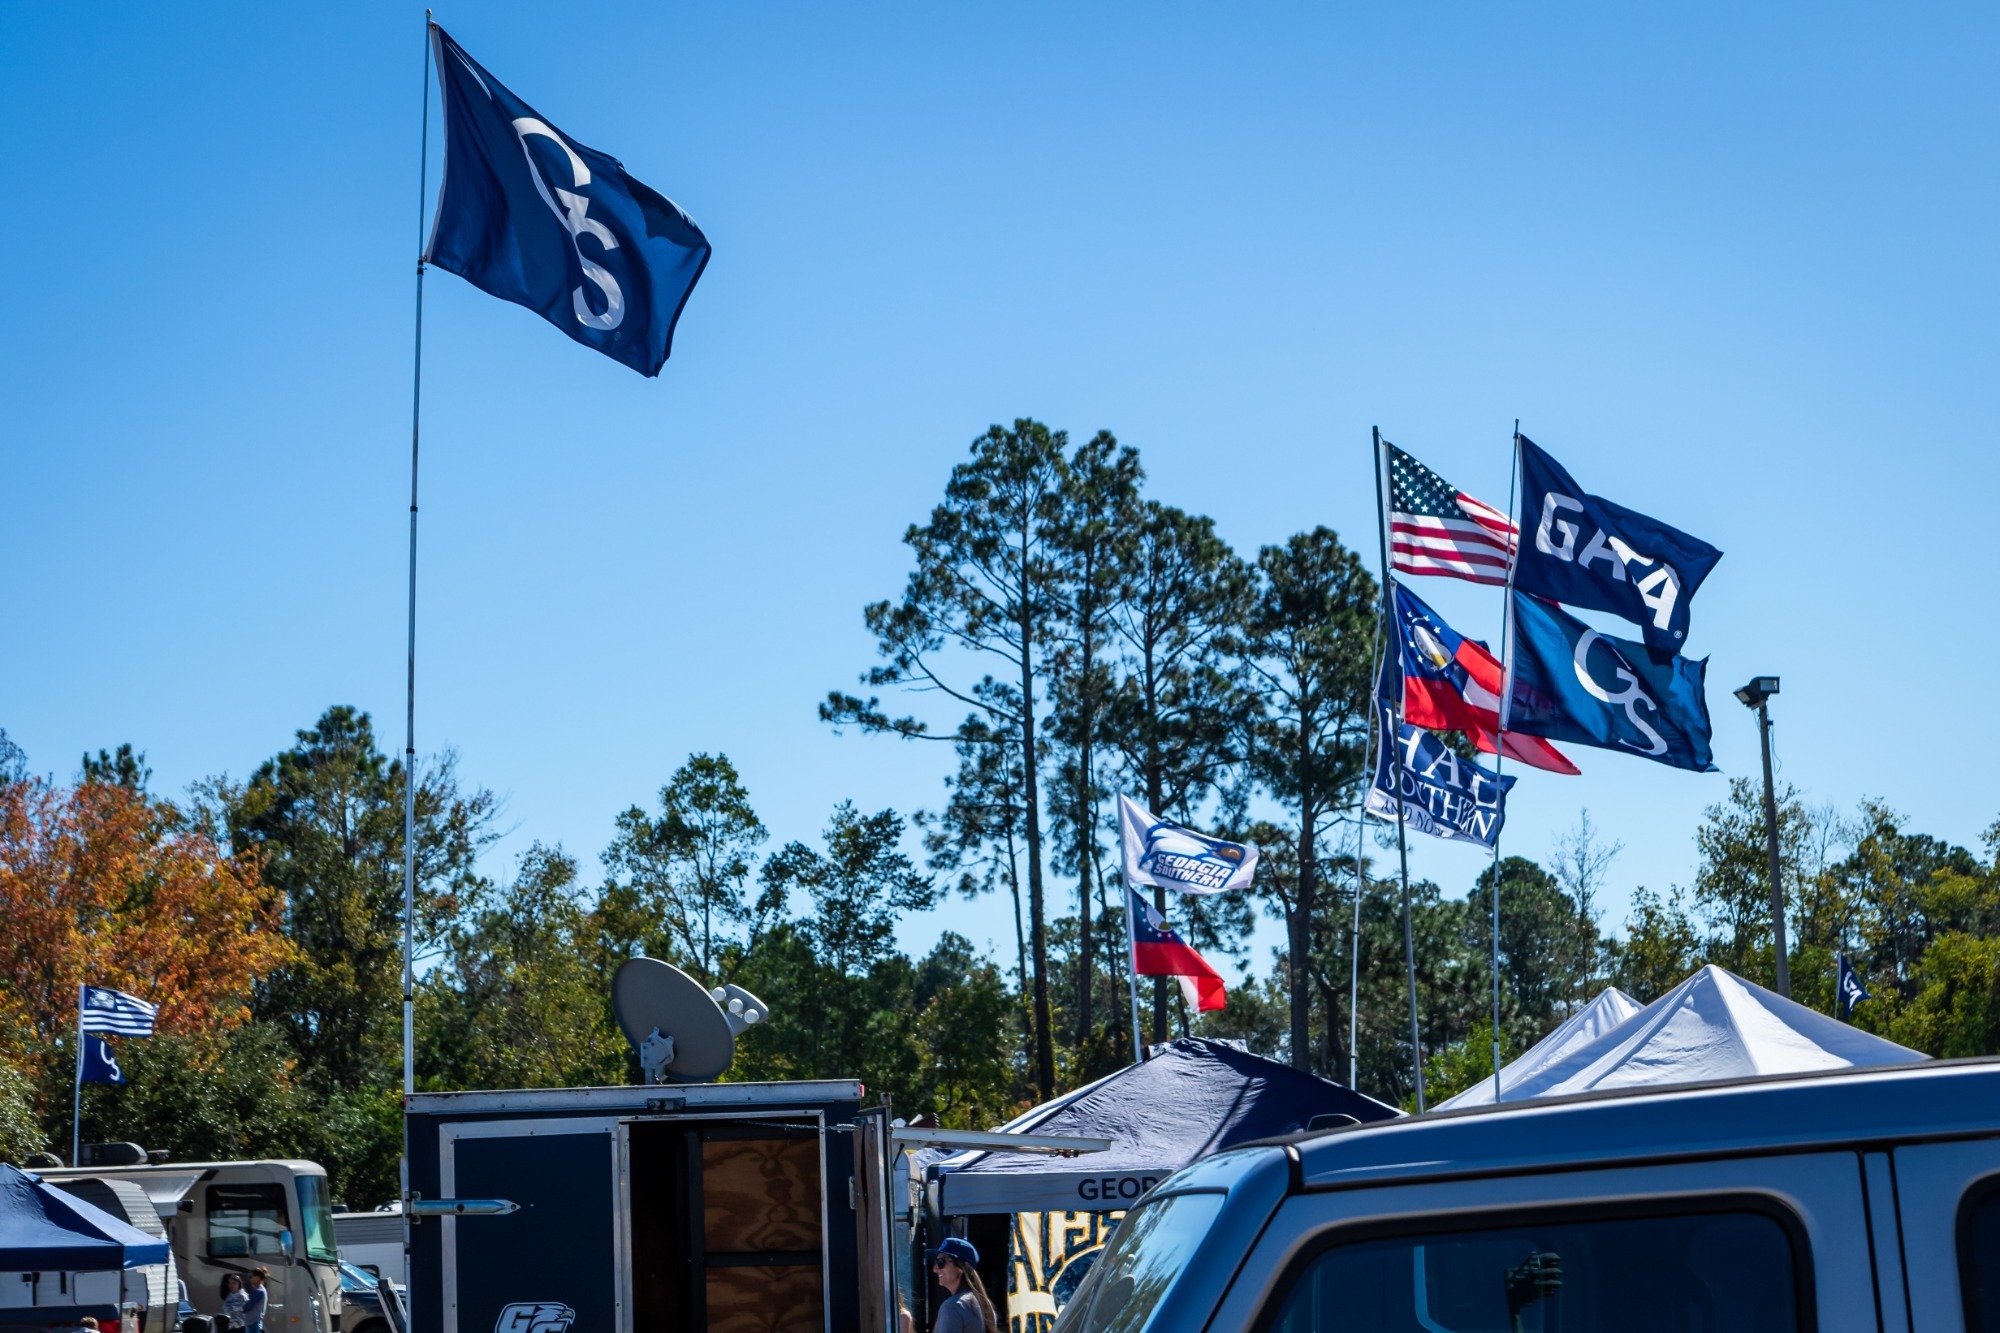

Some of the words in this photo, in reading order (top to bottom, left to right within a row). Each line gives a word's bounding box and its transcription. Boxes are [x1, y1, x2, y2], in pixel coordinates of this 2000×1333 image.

[1574, 628, 1668, 755] GS
[1153, 863, 1225, 888] SOUTHERN
[1157, 853, 1232, 879] GEORGIA
